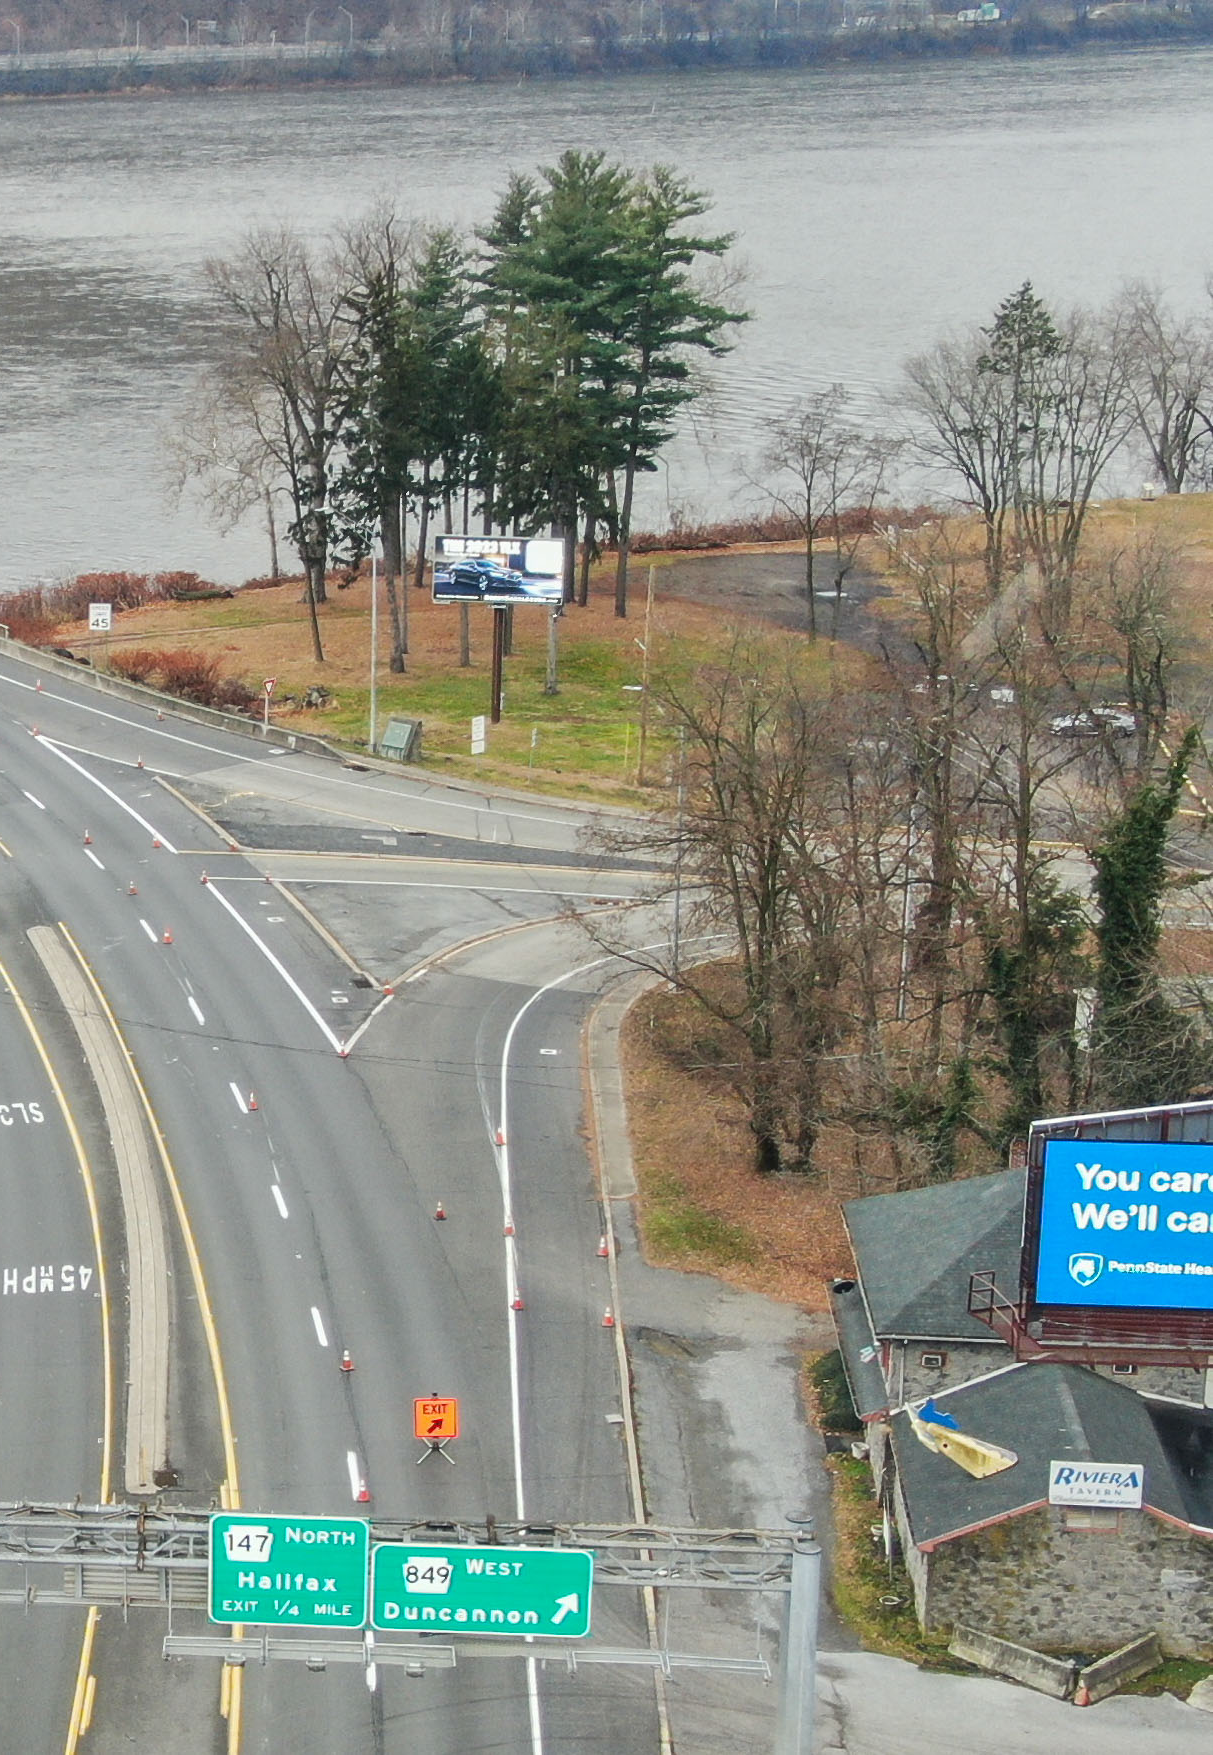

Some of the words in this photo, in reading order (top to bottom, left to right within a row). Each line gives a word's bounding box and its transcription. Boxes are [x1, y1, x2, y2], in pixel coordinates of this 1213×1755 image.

[91, 618, 109, 628] 45
[1075, 1163, 1141, 1192] You
[1149, 1170, 1213, 1193] car
[2, 1265, 54, 1295] MPH
[60, 1264, 93, 1292] 45
[422, 1404, 448, 1415] EXIT
[1054, 1467, 1138, 1488] RIVIERA
[1069, 1487, 1122, 1496] TAVERN
[226, 1534, 269, 1553] 147
[285, 1527, 356, 1546] NORTH
[237, 1571, 338, 1593] Halifax
[405, 1566, 450, 1585] 849
[466, 1558, 523, 1577] WEST
[222, 1600, 259, 1613] EXIT
[314, 1603, 353, 1617] MILE
[383, 1602, 540, 1625] Duncannon
